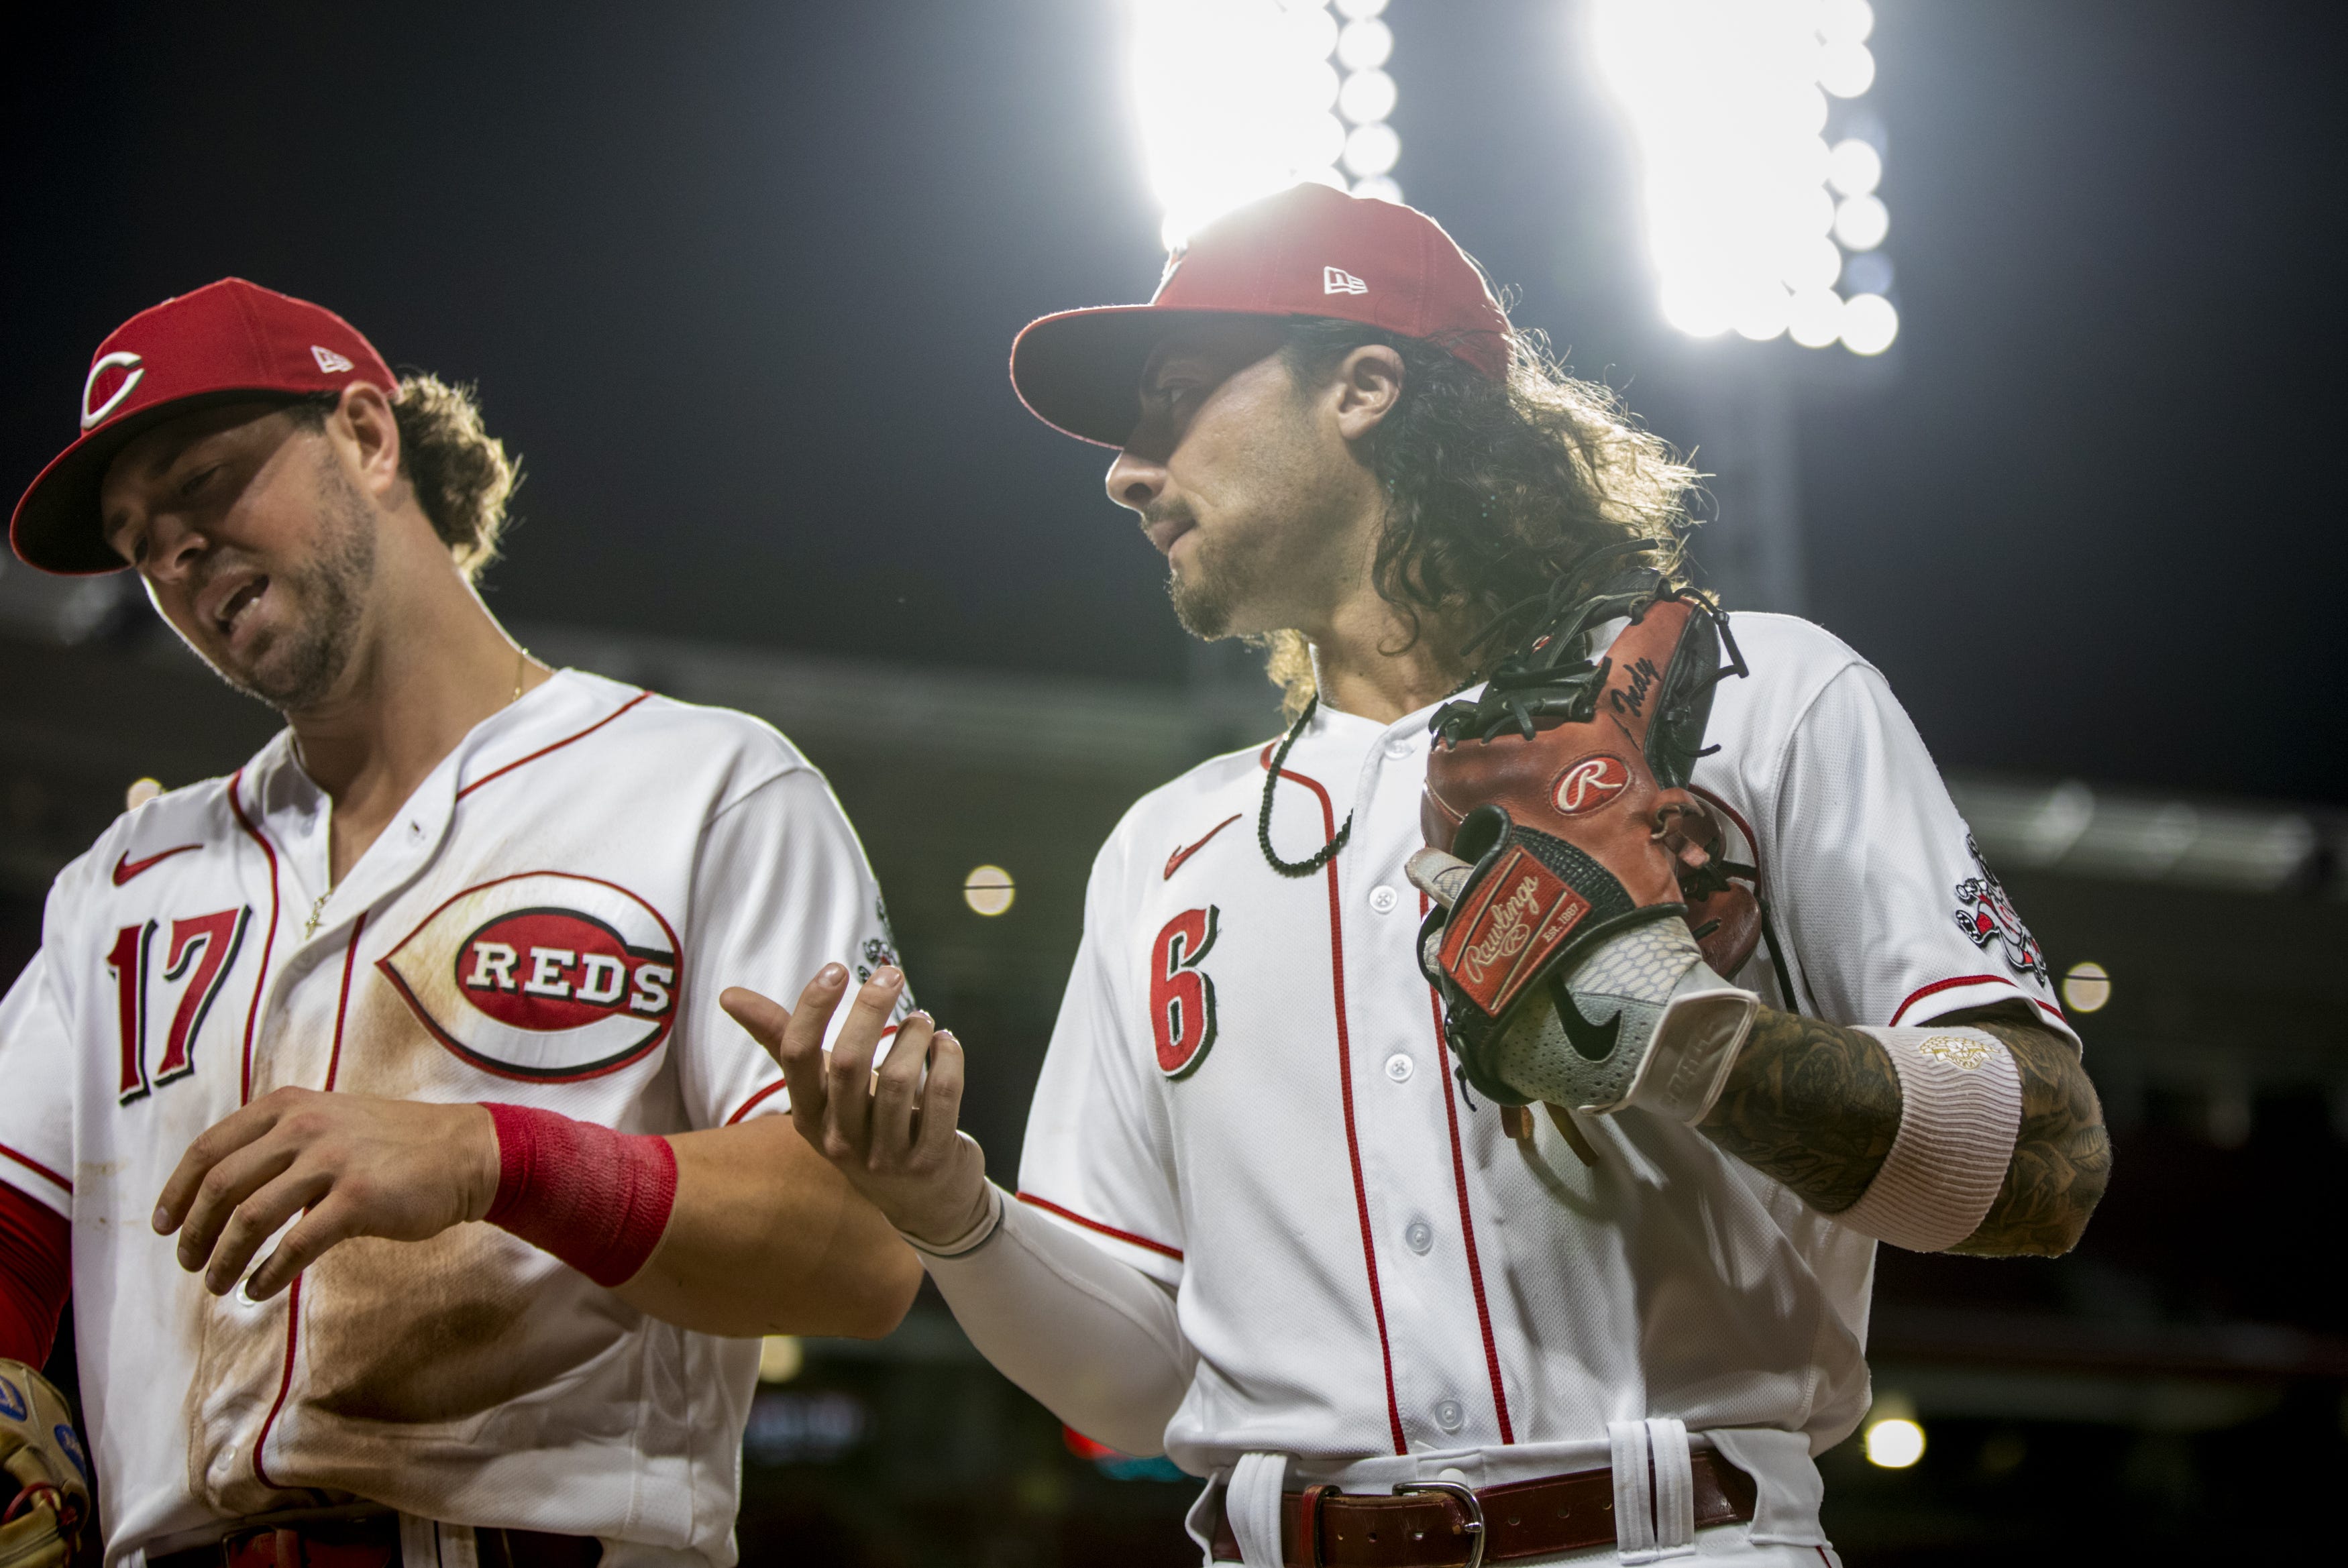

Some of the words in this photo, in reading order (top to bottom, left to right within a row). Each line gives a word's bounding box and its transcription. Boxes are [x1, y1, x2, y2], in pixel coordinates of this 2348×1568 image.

[1558, 760, 1623, 811] R
[1464, 876, 1540, 985] Rawlings
[1542, 926, 1563, 942] Est.
[1558, 902, 1579, 924] 1887
[106, 904, 253, 1107] 17
[466, 941, 675, 1018] REDS
[1150, 904, 1220, 1080] 6
